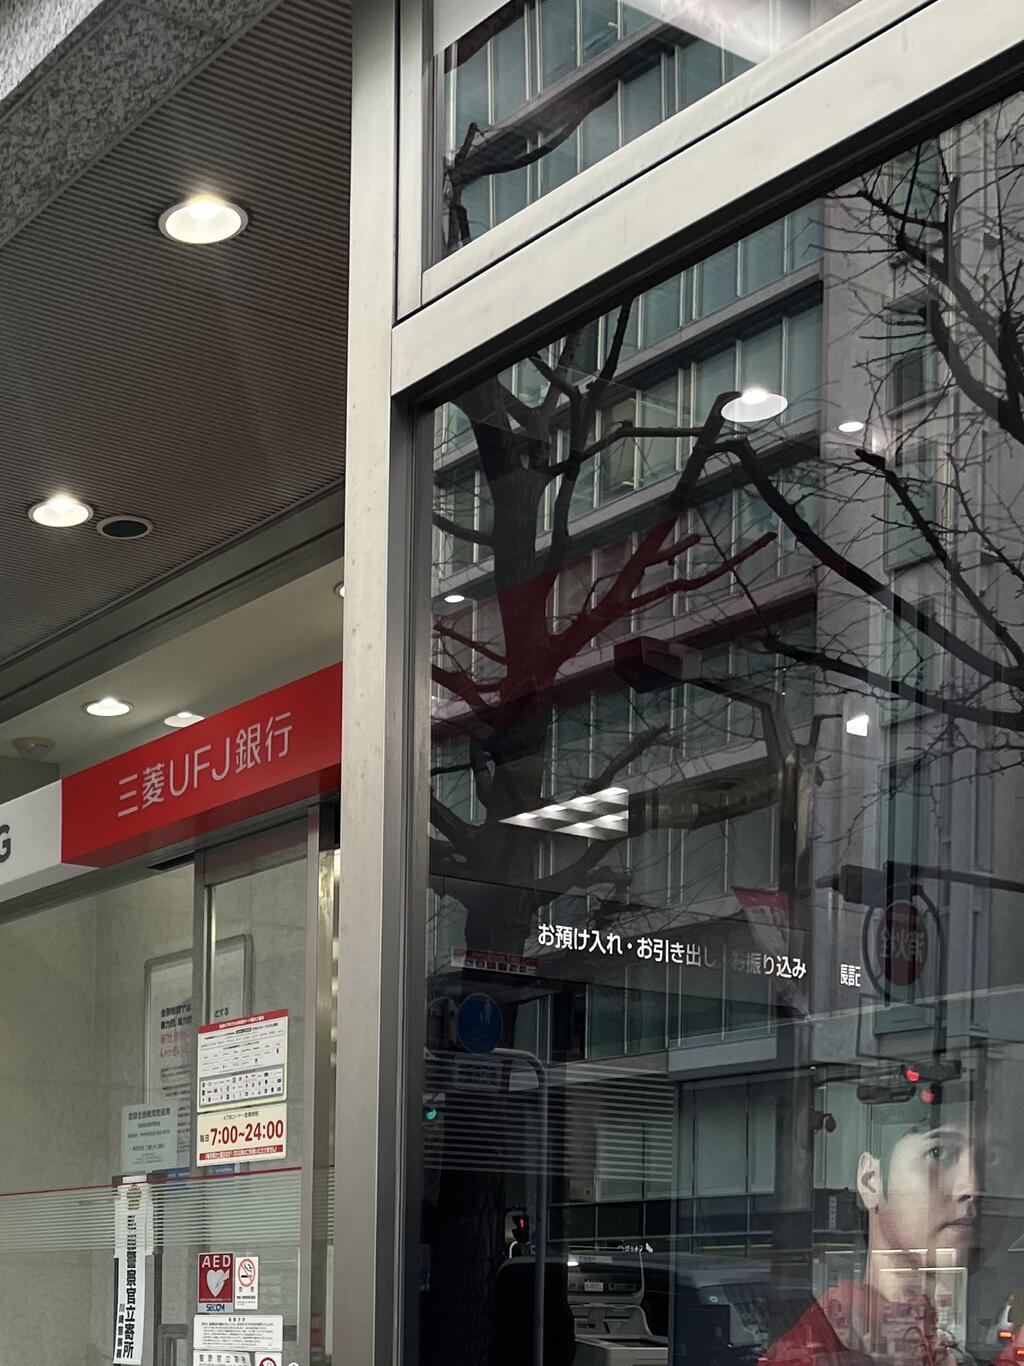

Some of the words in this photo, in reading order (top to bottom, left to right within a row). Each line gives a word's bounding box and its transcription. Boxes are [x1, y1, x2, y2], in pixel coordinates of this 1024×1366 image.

[117, 711, 294, 818] 三菱UFJ銀行
[202, 1255, 231, 1268] AED
